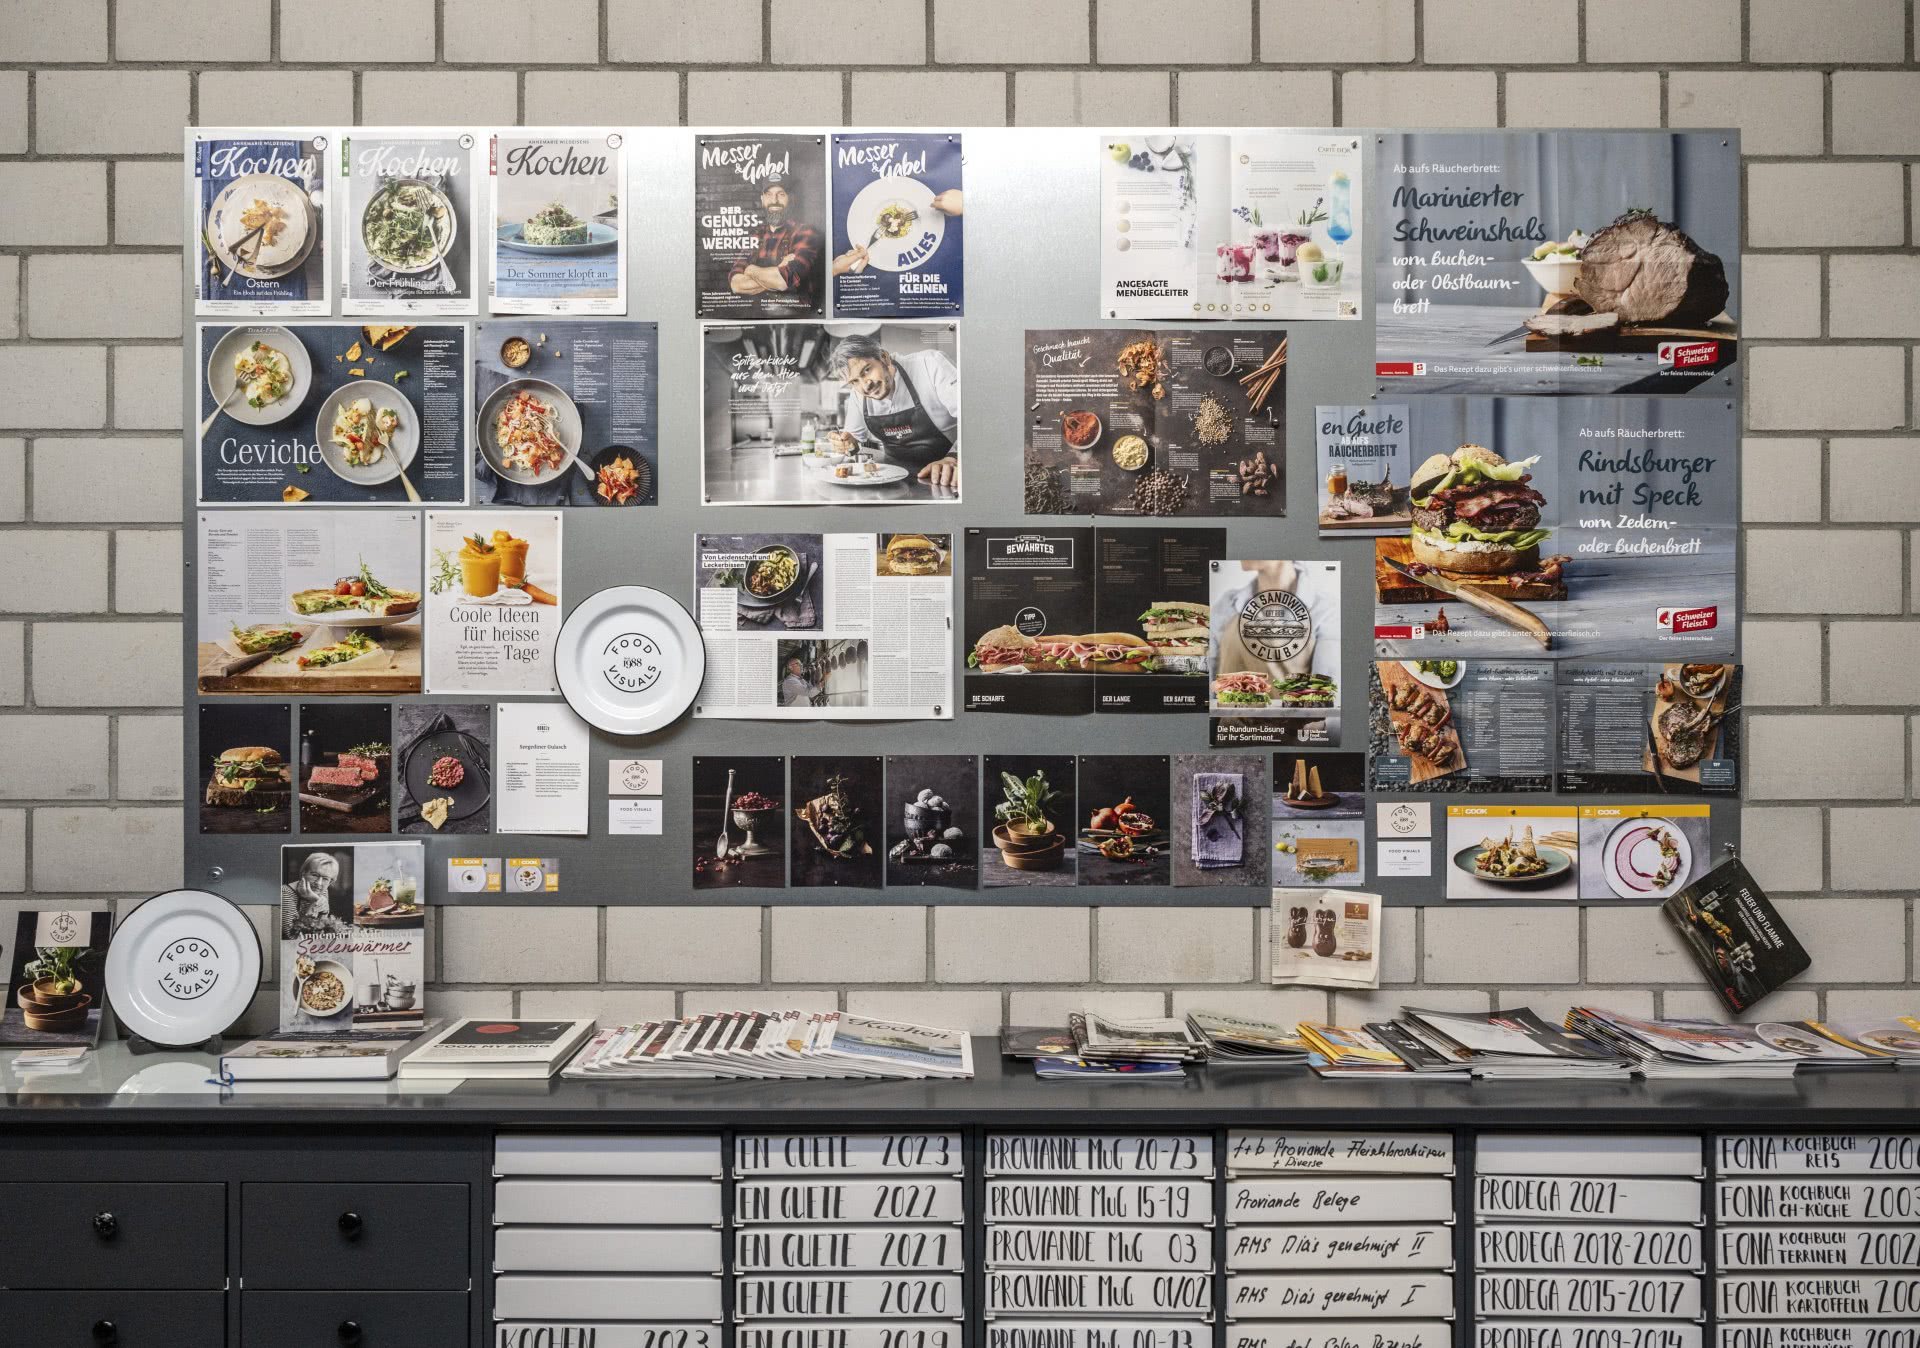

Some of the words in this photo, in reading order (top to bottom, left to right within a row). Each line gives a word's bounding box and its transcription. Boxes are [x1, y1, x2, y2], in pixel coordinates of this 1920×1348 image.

[211, 146, 316, 177] Kochen
[359, 146, 460, 177] Kochen
[507, 145, 609, 176] Kochen
[702, 143, 762, 169] Messer
[839, 143, 899, 169] Messer
[1393, 164, 1407, 173] Ab
[1409, 163, 1430, 173] aufs
[1431, 163, 1500, 173] Räucherbrett:
[1393, 184, 1525, 209] Marinierter
[720, 206, 742, 215] DER
[702, 214, 763, 228] GENUSS-
[1393, 217, 1548, 243] Schweinshals
[702, 236, 760, 250] WERKER
[897, 231, 937, 267] ALLES
[1393, 254, 1427, 266] vom
[1431, 250, 1495, 267] Buchen-
[507, 269, 526, 278] Der
[528, 269, 566, 278] Sommer
[568, 268, 595, 280] klopft
[899, 272, 920, 283] FÜR
[922, 274, 940, 283] DIE
[1393, 276, 1427, 290] oder
[1431, 274, 1521, 291] Obstbaum-
[246, 278, 280, 289] Ostern
[899, 283, 948, 294] KLEINEN
[1116, 280, 1169, 288] ANGESAGTE
[1116, 287, 1189, 297] MENÜBEGLEITER
[1393, 299, 1431, 315] brett
[1043, 349, 1082, 367] Qualität
[1677, 345, 1716, 357] Schweizer
[1683, 354, 1709, 364] Fleisch
[731, 370, 749, 380] aus
[777, 368, 800, 380] Hier
[1434, 365, 1447, 373] Das
[1448, 365, 1473, 375] Rezept
[1474, 364, 1491, 373] dazu
[1492, 364, 1513, 375] gibt's
[1513, 365, 1533, 373] unter
[1322, 422, 1346, 436] en
[1346, 414, 1403, 440] Guete
[1579, 429, 1593, 438] Ab
[1594, 428, 1615, 438] aufs
[1617, 428, 1685, 438] Räucherbrett:
[220, 437, 323, 465] Ceviche
[1329, 443, 1397, 457] RÄUCHERBRETT
[1578, 448, 1717, 483] Rindsburger
[1579, 483, 1623, 505] mit
[1632, 481, 1702, 514] Speck
[1579, 517, 1613, 530] vom
[1615, 514, 1678, 530] Zedern-
[1006, 541, 1054, 554] BEWÄHRTES
[1578, 539, 1611, 553] oder
[1614, 536, 1702, 554] Buchenbrett
[450, 606, 492, 623] Coole
[499, 606, 539, 623] Ideen
[1242, 600, 1261, 621] DER
[1259, 592, 1308, 621] SANDWICH
[1023, 613, 1036, 621] TIPP
[1676, 611, 1715, 622] Schweizer
[1682, 619, 1708, 629] Fleisch
[464, 626, 486, 641] für
[493, 626, 540, 641] heisse
[1447, 629, 1472, 639] Rezept
[1473, 629, 1491, 637] dazu
[504, 644, 540, 663] Tage
[611, 638, 653, 655] FOOD
[1257, 646, 1292, 660] CLUB
[623, 658, 643, 669] 1988
[608, 664, 657, 688] VISUALS
[1217, 725, 1228, 733] Die
[1229, 725, 1285, 735] Rundum-Lösung
[626, 766, 645, 774] FOOD
[625, 777, 646, 788] VISUALS
[1394, 808, 1413, 817] FOOD
[1393, 820, 1415, 831] VISUALS
[1739, 887, 1758, 909] FEUER
[1752, 906, 1767, 923] UND
[1761, 919, 1785, 949] FLAMME
[166, 942, 209, 962] FOOD
[296, 938, 413, 955] Seelenwärmer
[178, 964, 199, 975] 1988
[163, 967, 214, 995] VISUALS
[847, 1018, 952, 1040] Kochen
[740, 1137, 770, 1169] EN
[784, 1135, 857, 1169] GUETE
[882, 1135, 949, 1168] 2023
[989, 1137, 1082, 1171] PROVIANDE
[1087, 1137, 1123, 1170] MuG
[1134, 1137, 1198, 1171] 20-23
[1273, 1136, 1334, 1159] Proviande
[1722, 1137, 1777, 1169] FONA
[1783, 1136, 1856, 1152] KOCHBUCH
[1284, 1156, 1323, 1168] Diverse
[1805, 1152, 1840, 1168] REIS
[740, 1186, 770, 1220] EN
[781, 1185, 847, 1220] GUETE
[873, 1184, 937, 1219] 2022
[991, 1186, 1084, 1218] PROVIANDE
[1090, 1186, 1127, 1218] MuG
[1137, 1185, 1190, 1218] 15-19
[1235, 1189, 1300, 1209] Proviande
[1313, 1190, 1361, 1212] Belege
[1480, 1180, 1560, 1212] PRODEGA
[1569, 1181, 1628, 1214] 2021-
[1721, 1185, 1775, 1218] FONA
[1780, 1185, 1851, 1201] KOCHBUCH
[1779, 1202, 1851, 1218] CH-KÜCHE
[740, 1233, 771, 1267] EN
[781, 1233, 857, 1267] GUETE
[880, 1232, 947, 1267] 2021
[992, 1231, 1096, 1263] PROVIANDE
[1109, 1232, 1144, 1262] MuG
[1168, 1233, 1197, 1263] 03
[1234, 1236, 1271, 1256] AMS
[1327, 1236, 1400, 1259] genehmigt
[1480, 1230, 1566, 1265] PRODEGA
[1573, 1231, 1692, 1266] 2018-2020
[1722, 1232, 1775, 1265] FONA
[1779, 1232, 1846, 1245] KOCHBUCH
[1778, 1249, 1847, 1265] TERRINEN
[740, 1281, 775, 1315] EN
[782, 1280, 850, 1315] GUETE
[879, 1281, 946, 1315] 2020
[990, 1275, 1087, 1308] PROVIANDE
[1098, 1275, 1134, 1307] MuG
[1153, 1275, 1208, 1309] 01/02
[1236, 1286, 1268, 1304] AMS
[1322, 1286, 1390, 1311] genehmigt
[1480, 1278, 1559, 1313] PRODEGA
[1567, 1279, 1685, 1314] 2015-2017
[1723, 1280, 1778, 1314] FONA
[1786, 1280, 1860, 1296] KOCHBUCH
[1787, 1298, 1869, 1314] KARTOFFELN
[1780, 1328, 1851, 1342] KOCHBUCH
